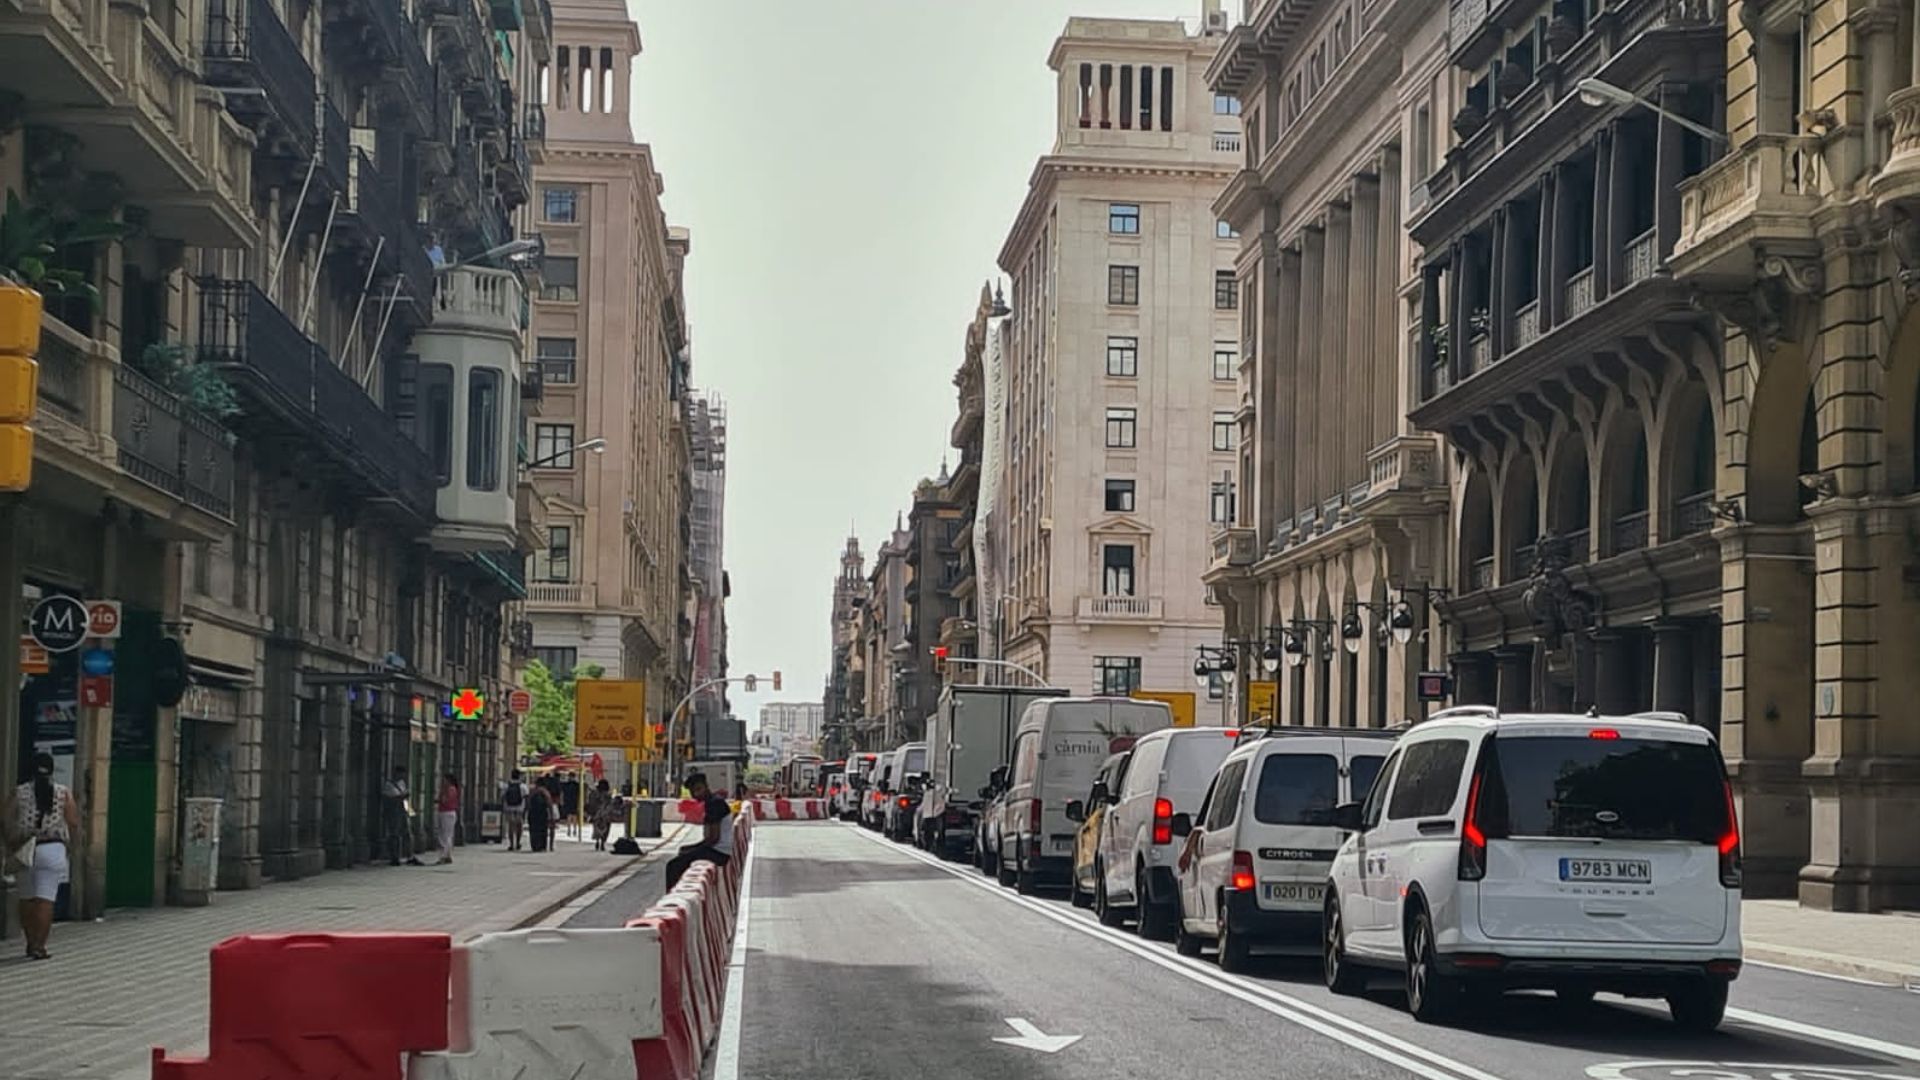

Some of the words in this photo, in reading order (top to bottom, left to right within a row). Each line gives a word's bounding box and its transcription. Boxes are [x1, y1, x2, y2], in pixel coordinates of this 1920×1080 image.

[44, 606, 73, 631] M
[90, 607, 115, 623] ria
[1571, 862, 1612, 877] 9783
[1617, 863, 1647, 877] MCN
[1273, 886, 1303, 899] 0201
[1308, 887, 1324, 900] DX
